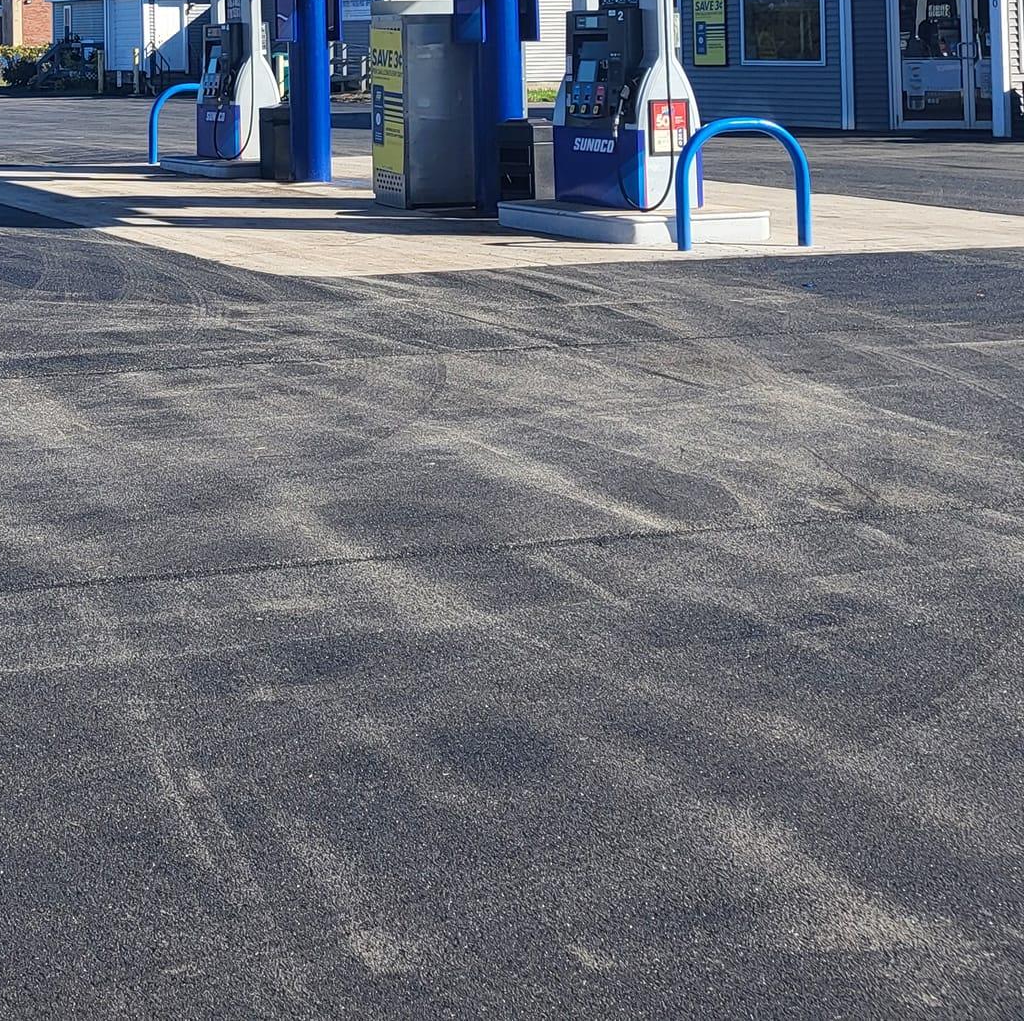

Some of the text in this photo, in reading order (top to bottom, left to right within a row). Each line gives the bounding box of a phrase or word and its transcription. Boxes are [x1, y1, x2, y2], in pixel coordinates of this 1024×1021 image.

[695, 0, 714, 12] SAVE
[617, 10, 624, 21] 2
[372, 47, 393, 68] SAVE
[573, 137, 615, 153] SUNOCO
